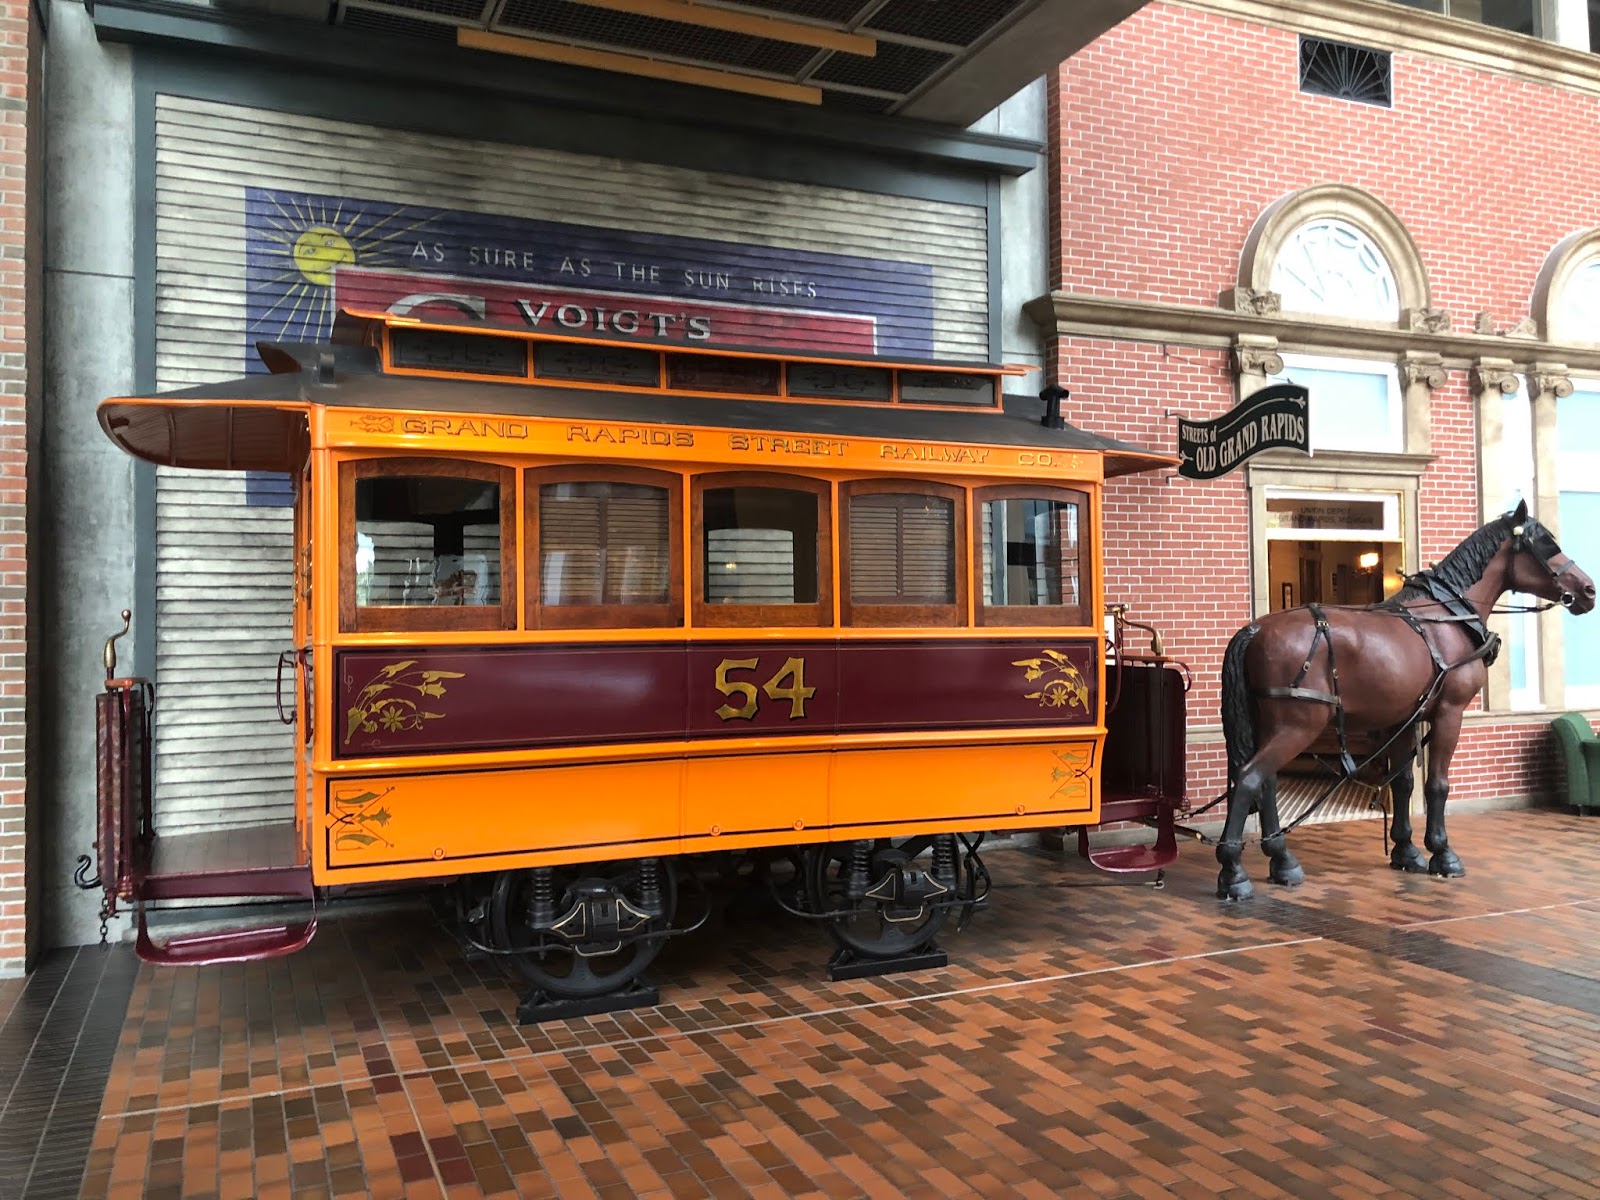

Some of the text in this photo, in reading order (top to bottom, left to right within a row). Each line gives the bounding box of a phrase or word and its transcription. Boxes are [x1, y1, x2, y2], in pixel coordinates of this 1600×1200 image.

[412, 240, 445, 262] AS
[468, 246, 534, 271] SURE
[560, 256, 592, 277] AS
[614, 261, 661, 284] THE
[684, 269, 730, 290] SUN
[517, 298, 711, 340] VOIGT'S
[401, 416, 1057, 467] GRAND RAPIDS STREET RAILWAY CO.
[1182, 424, 1217, 443] STREETS of
[1196, 413, 1305, 472] OLD GRAND RAPIDS
[714, 656, 817, 720] 54
